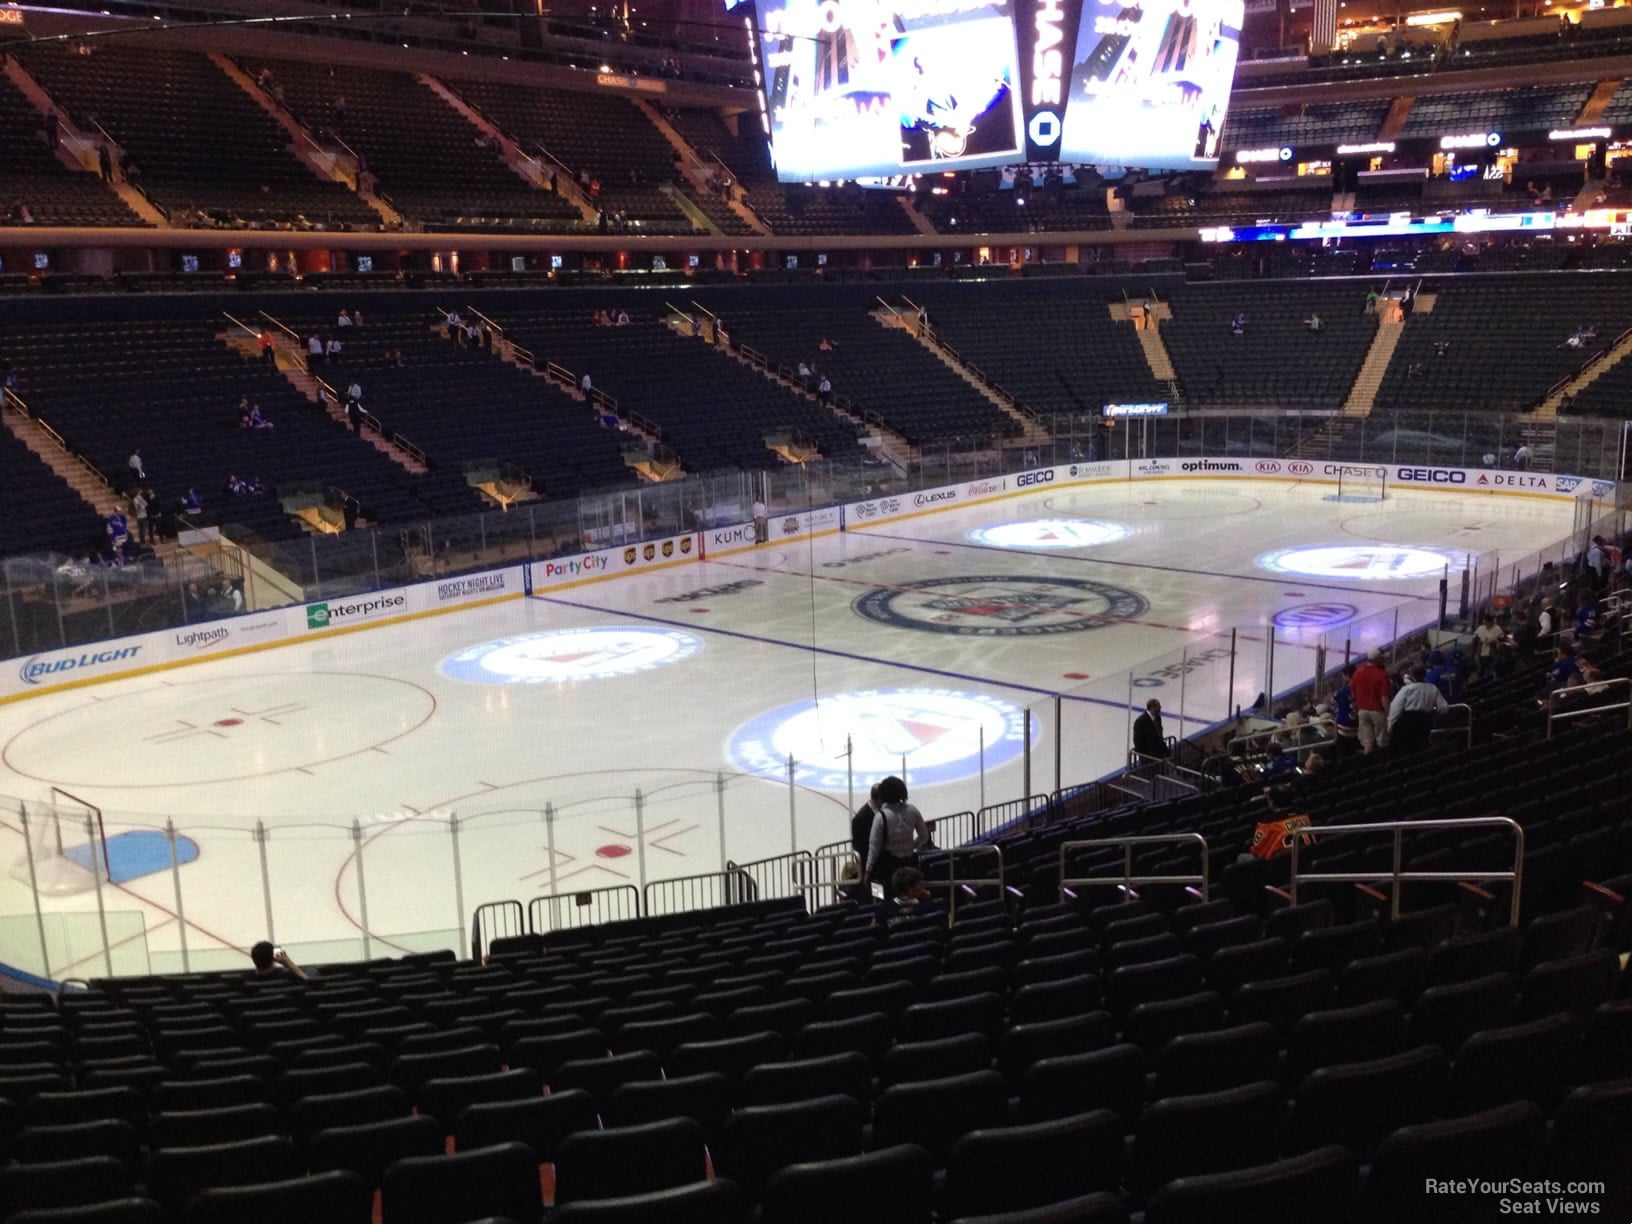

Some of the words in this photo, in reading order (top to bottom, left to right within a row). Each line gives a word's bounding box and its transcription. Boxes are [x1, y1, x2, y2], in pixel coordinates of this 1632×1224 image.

[1259, 463, 1277, 471] KIA
[1292, 465, 1309, 473] KIA
[1324, 464, 1372, 477] CHASE
[1017, 470, 1054, 487] GEICO
[1397, 468, 1466, 484] GEICO
[1494, 475, 1547, 488] DELTA
[1556, 478, 1577, 490] SAP
[925, 490, 956, 502] LEXUS
[438, 580, 466, 595] HOCKEY
[467, 575, 488, 589] NIGHT
[489, 573, 504, 585] LIVE
[314, 595, 404, 621] enterprise
[176, 626, 229, 646] Lightpath
[28, 658, 77, 678] BUD
[78, 645, 142, 668] LIGHT
